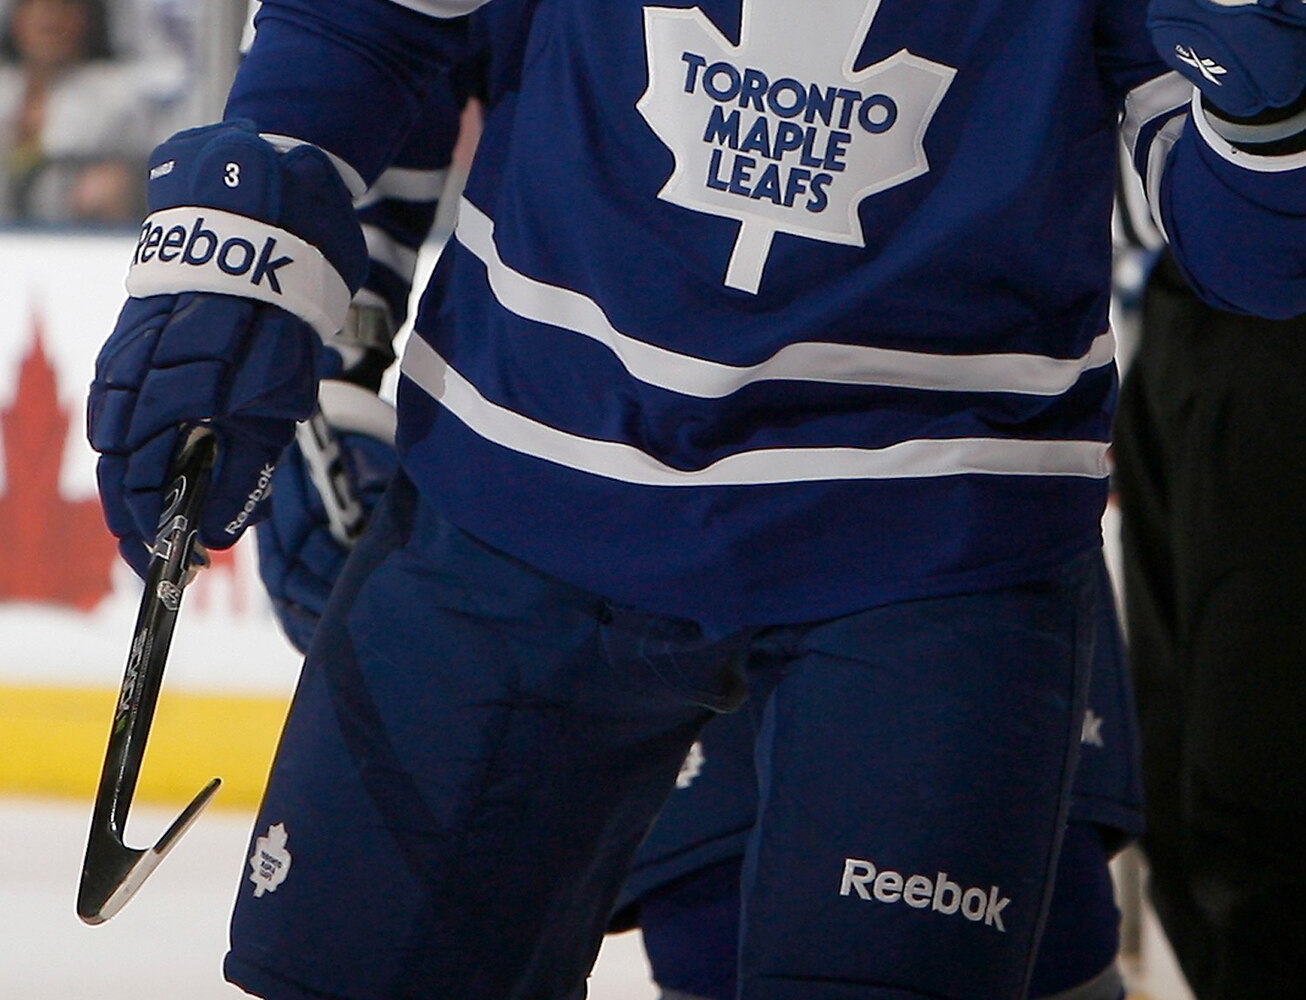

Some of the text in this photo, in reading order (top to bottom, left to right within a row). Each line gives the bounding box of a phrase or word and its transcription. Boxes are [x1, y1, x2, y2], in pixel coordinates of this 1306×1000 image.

[680, 50, 899, 135] TORONTO
[702, 104, 853, 173] MAPLE
[223, 162, 241, 188] 3
[705, 148, 834, 214] LEAFS
[223, 462, 276, 536] Reebok
[838, 857, 1012, 933] Reebok
